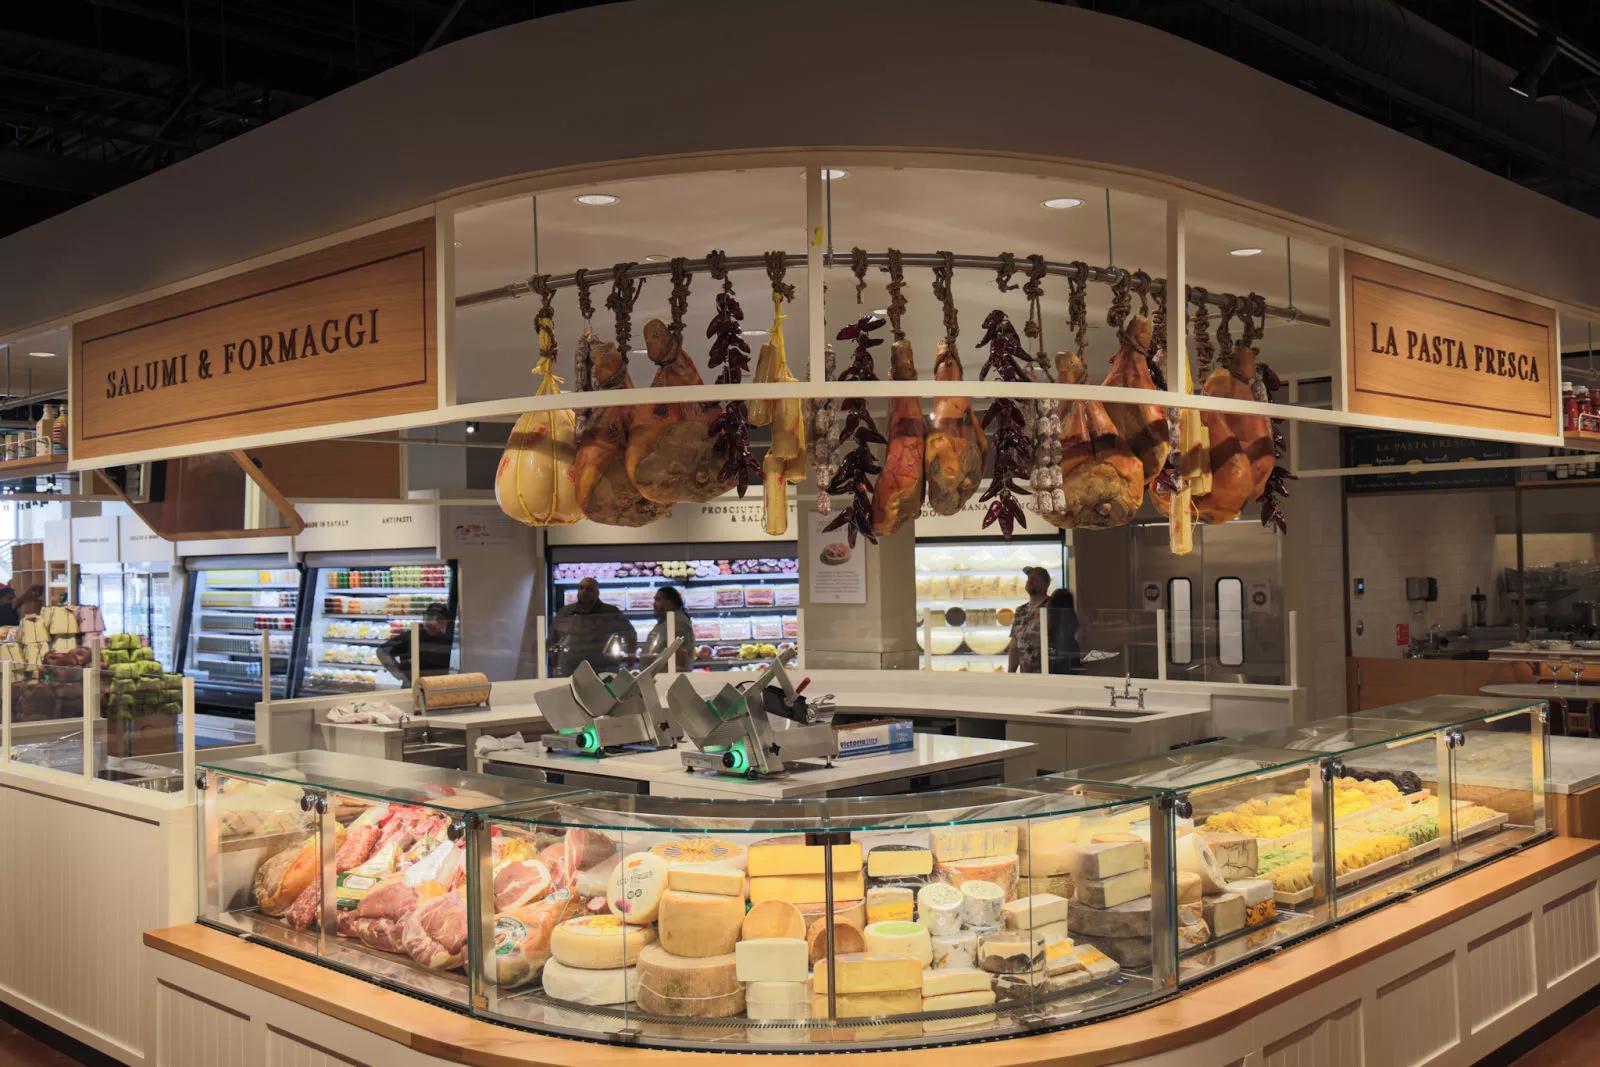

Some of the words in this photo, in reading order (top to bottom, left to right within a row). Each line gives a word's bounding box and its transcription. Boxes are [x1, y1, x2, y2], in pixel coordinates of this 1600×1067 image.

[106, 354, 189, 399] SALUMI
[198, 348, 213, 380] &
[224, 308, 379, 375] FORMAGGI
[1370, 322, 1399, 357] LA
[1406, 329, 1468, 369] PASTA
[1474, 344, 1540, 382] FRESCA
